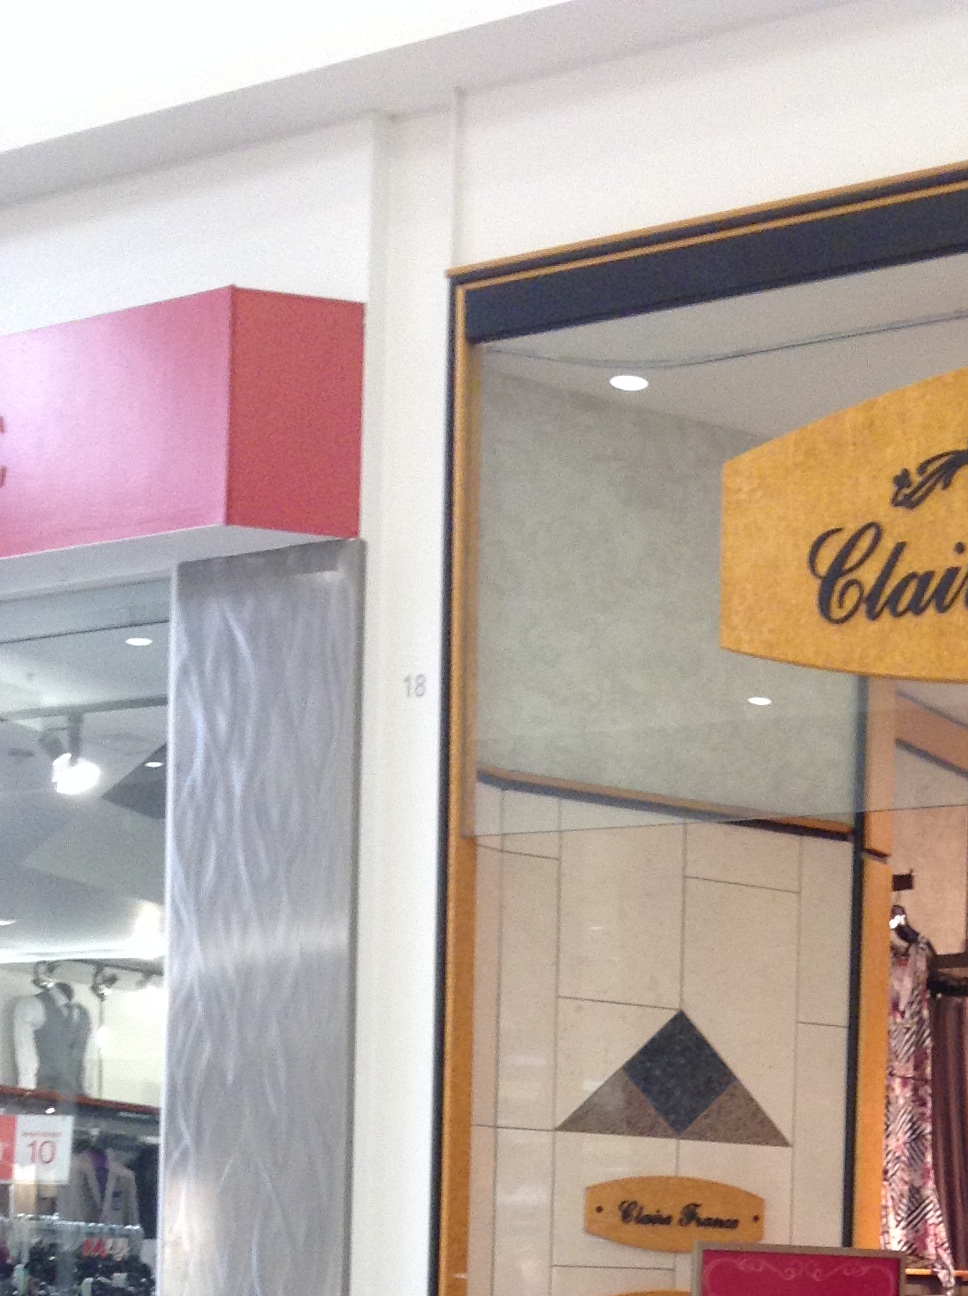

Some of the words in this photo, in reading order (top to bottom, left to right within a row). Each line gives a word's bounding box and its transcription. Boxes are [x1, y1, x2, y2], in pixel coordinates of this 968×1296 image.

[402, 673, 427, 699] 18
[618, 1200, 673, 1226] Claire
[677, 1202, 740, 1229] France
